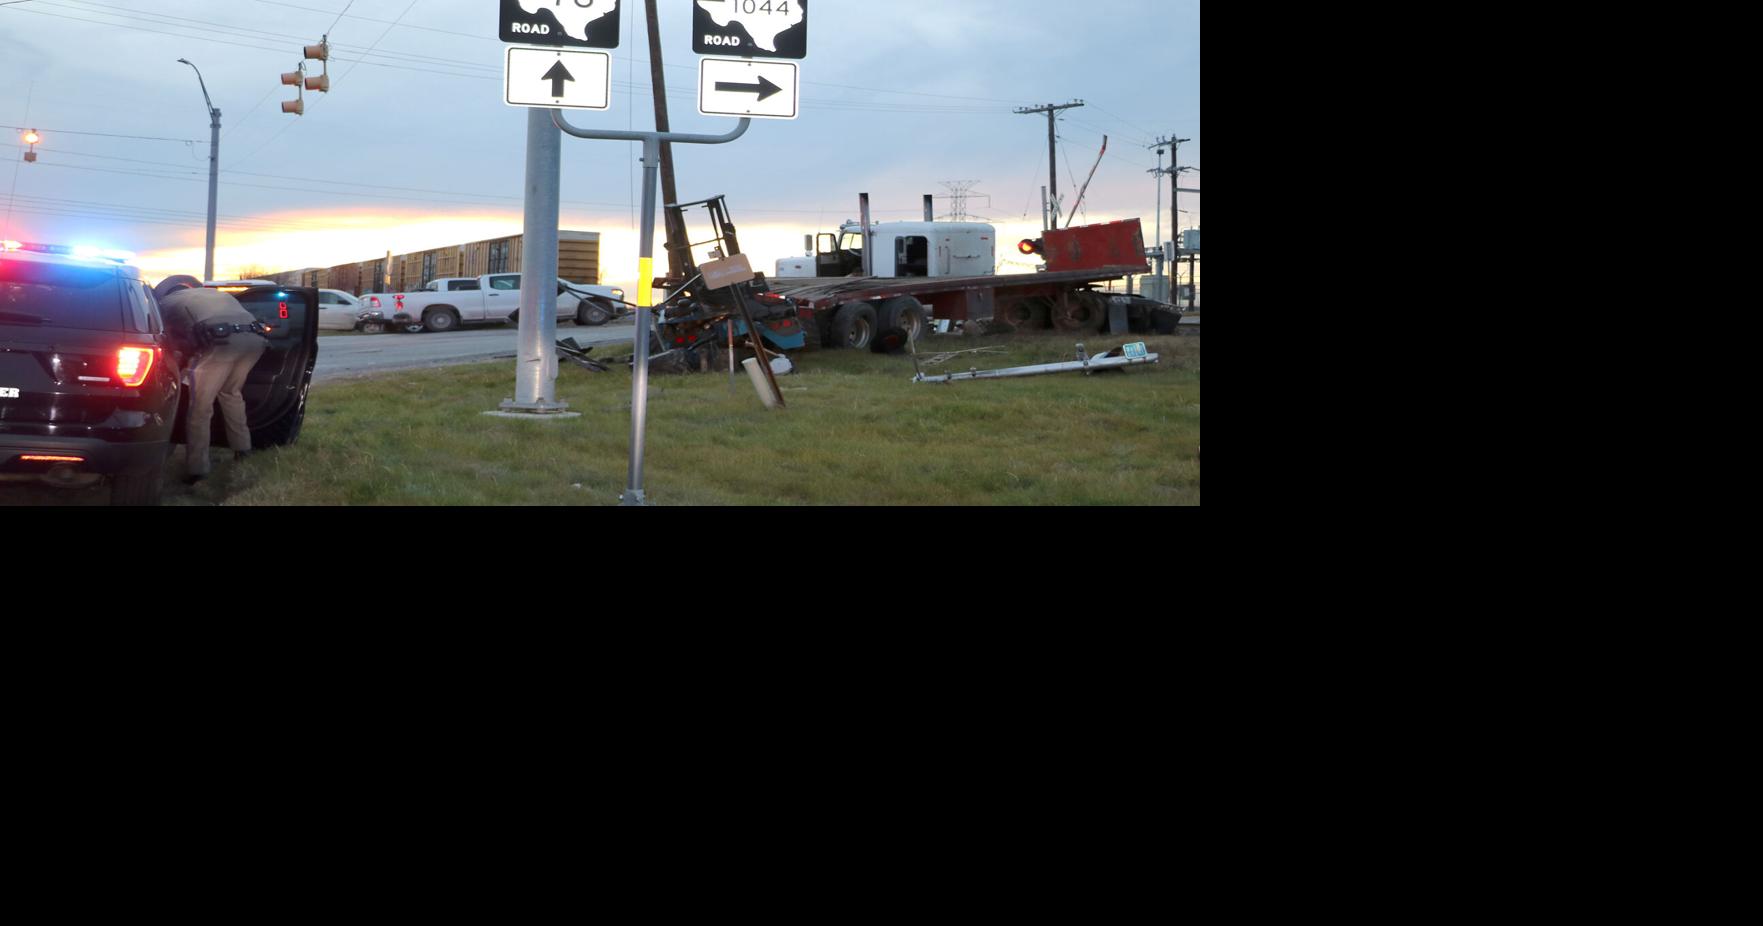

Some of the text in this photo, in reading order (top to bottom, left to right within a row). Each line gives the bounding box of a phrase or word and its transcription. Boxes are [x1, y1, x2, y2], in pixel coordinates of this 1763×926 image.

[734, 0, 789, 15] 1044
[512, 22, 550, 35] ROAD
[704, 34, 740, 46] ROAD
